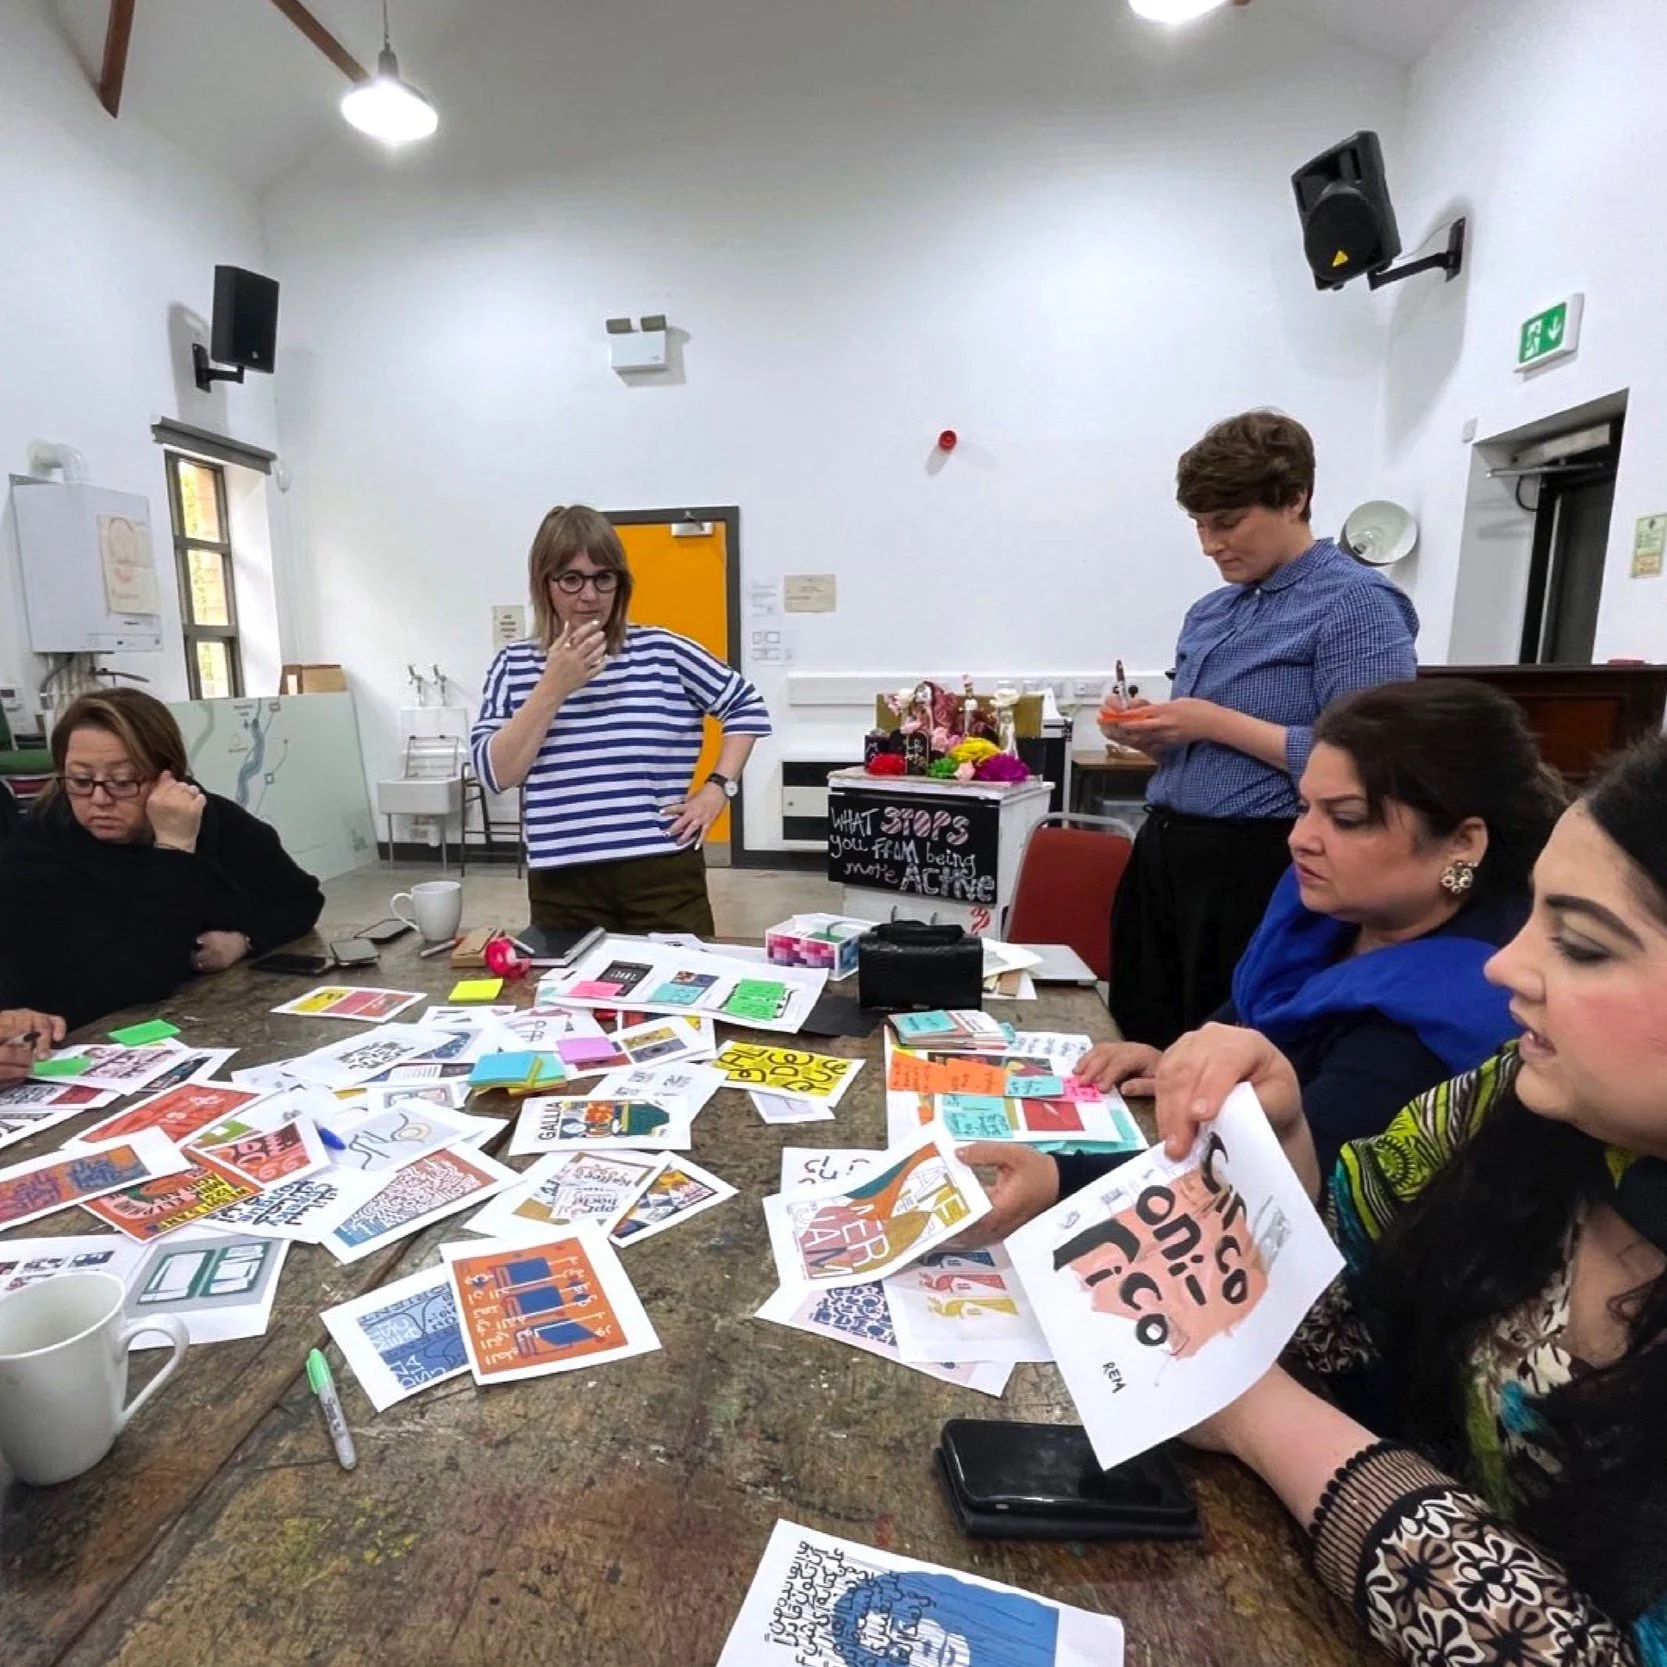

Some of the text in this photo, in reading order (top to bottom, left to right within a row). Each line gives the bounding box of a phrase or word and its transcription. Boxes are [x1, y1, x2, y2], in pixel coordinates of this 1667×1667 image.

[830, 805, 970, 846] WHAT STOPS
[829, 834, 868, 859] you
[925, 841, 977, 880] being
[537, 1100, 562, 1141] GALLIA
[1102, 1361, 1128, 1394] REM
